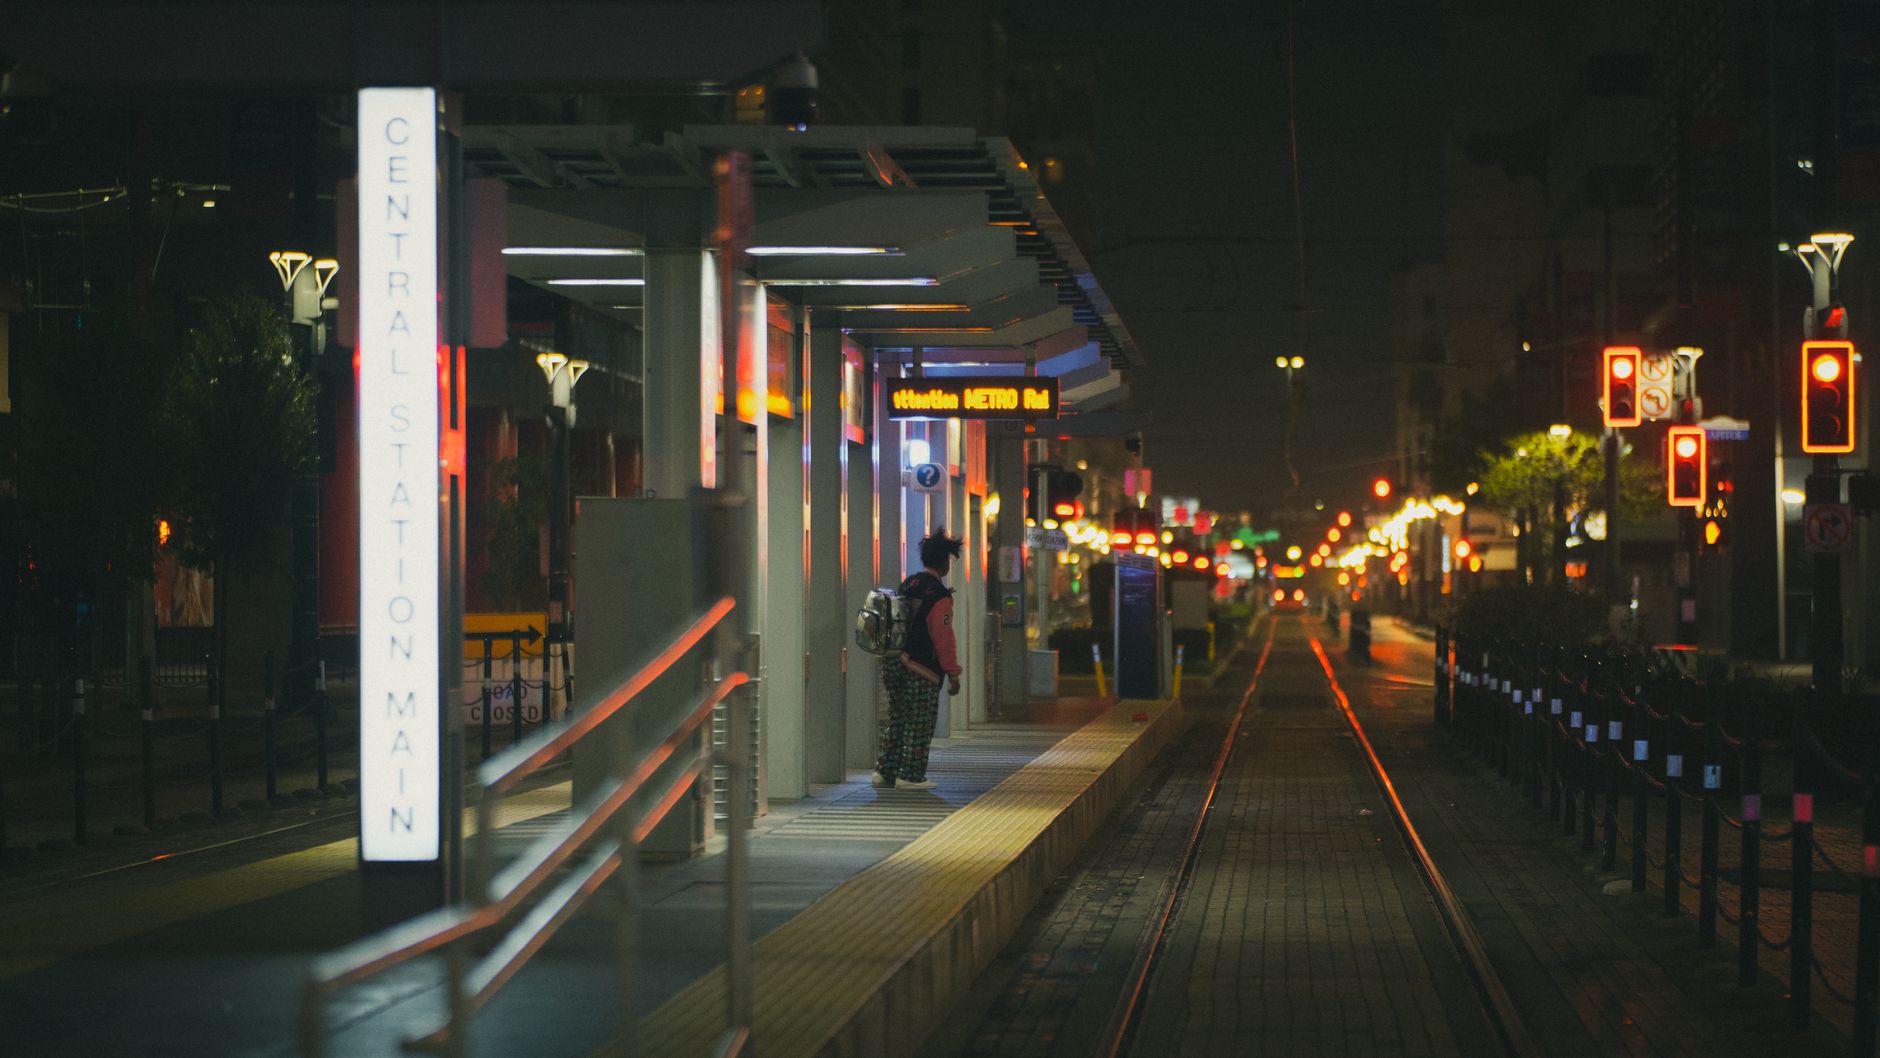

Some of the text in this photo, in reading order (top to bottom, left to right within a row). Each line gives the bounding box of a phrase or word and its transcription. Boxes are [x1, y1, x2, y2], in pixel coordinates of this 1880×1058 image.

[964, 388, 1018, 409] METRO
[384, 116, 415, 834] CENTRAL STATION MAIN
[489, 686, 528, 700] OAD
[471, 706, 538, 721] COSED
